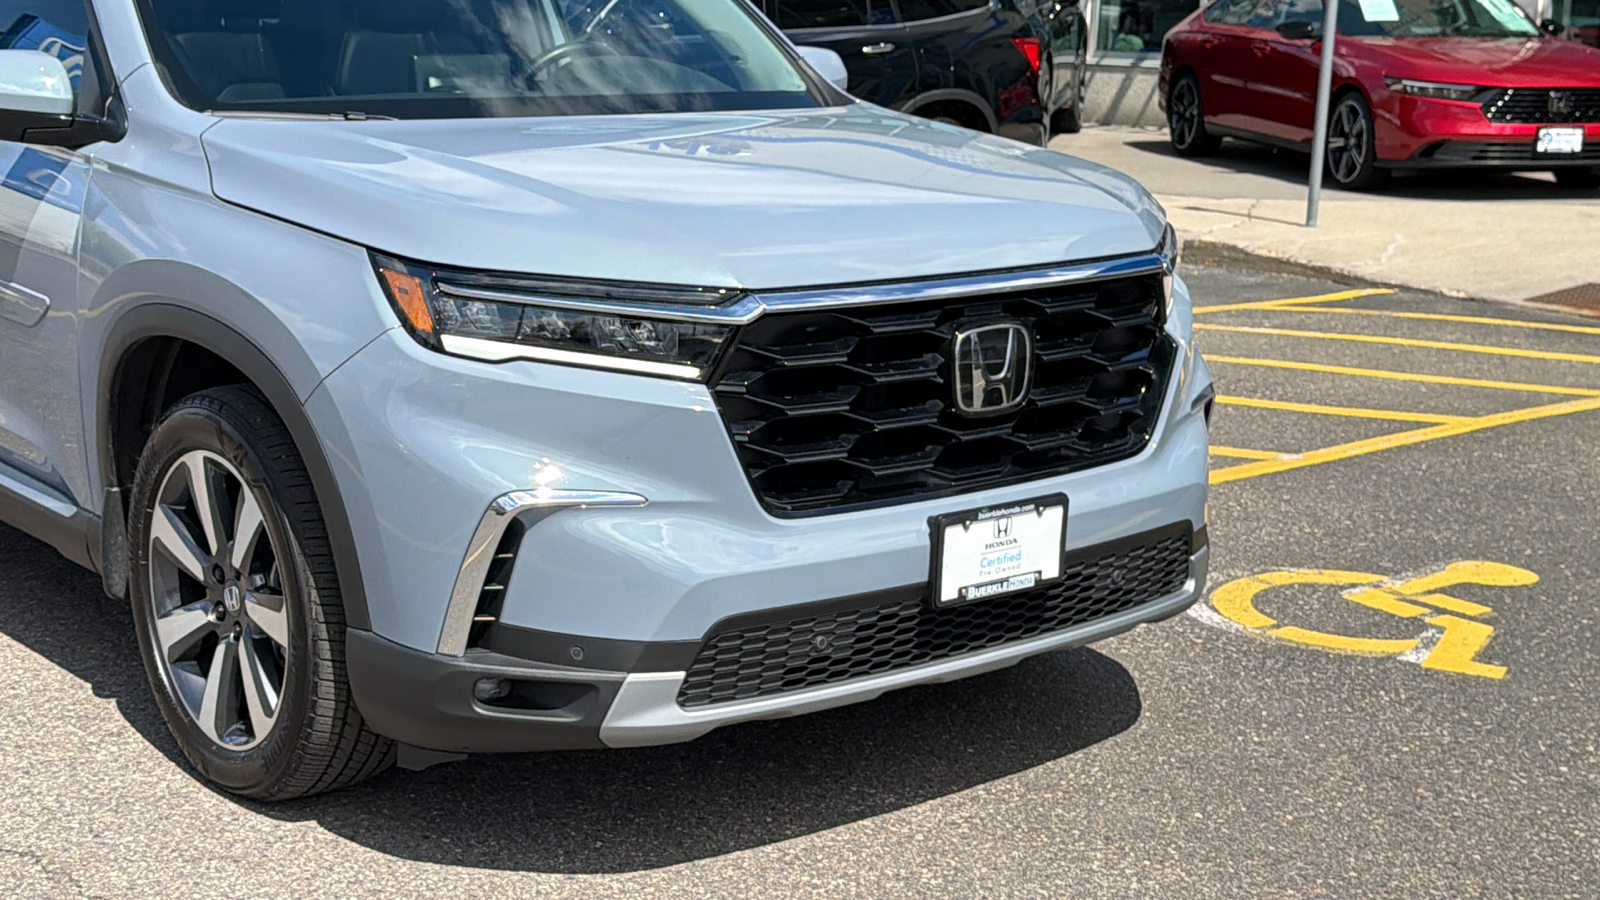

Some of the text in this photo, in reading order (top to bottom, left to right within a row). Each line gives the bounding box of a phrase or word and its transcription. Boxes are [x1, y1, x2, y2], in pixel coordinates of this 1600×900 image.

[985, 538, 1018, 549] HONDA
[980, 550, 1021, 568] Certified
[979, 563, 1021, 577] Pre-Owned
